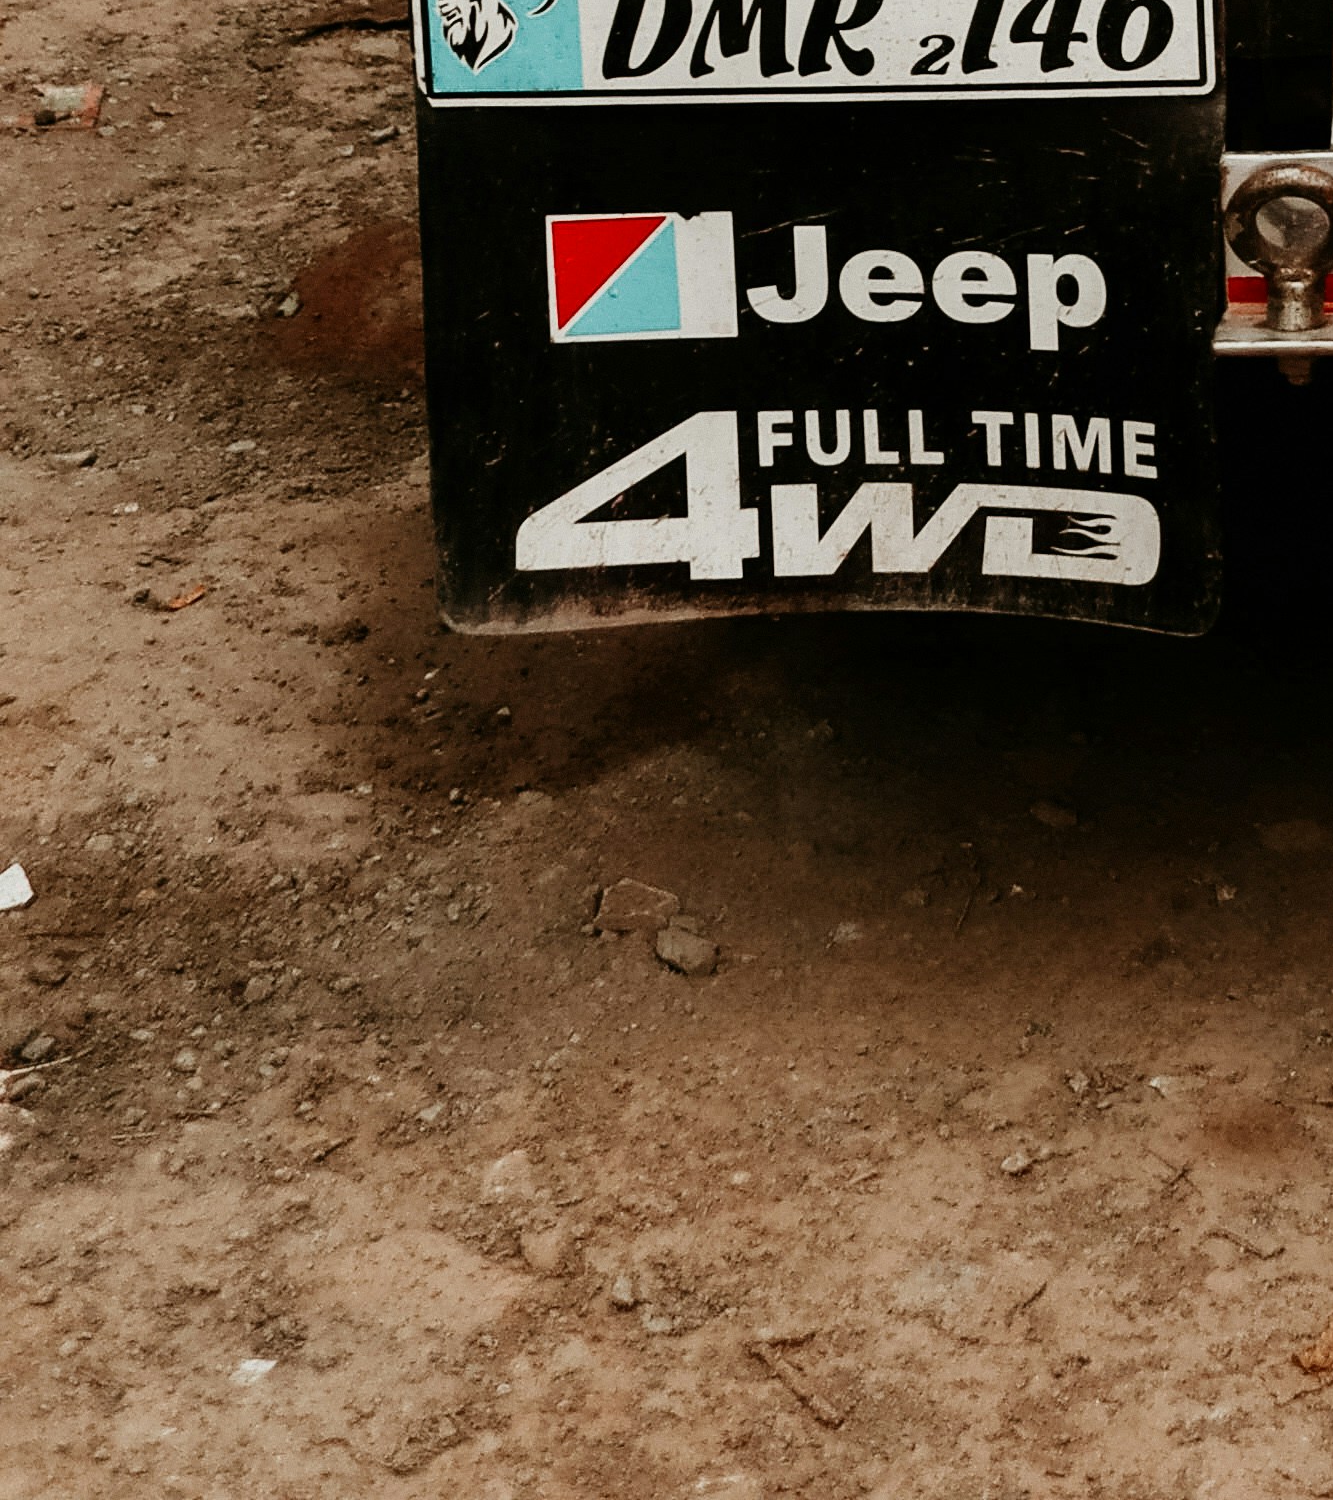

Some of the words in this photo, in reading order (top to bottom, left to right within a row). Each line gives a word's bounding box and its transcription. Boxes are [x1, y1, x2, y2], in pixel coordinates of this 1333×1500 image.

[745, 224, 1109, 353] Jeep
[514, 409, 1162, 588] 4WD
[756, 409, 946, 469] FULL
[971, 409, 1160, 481] TIME
